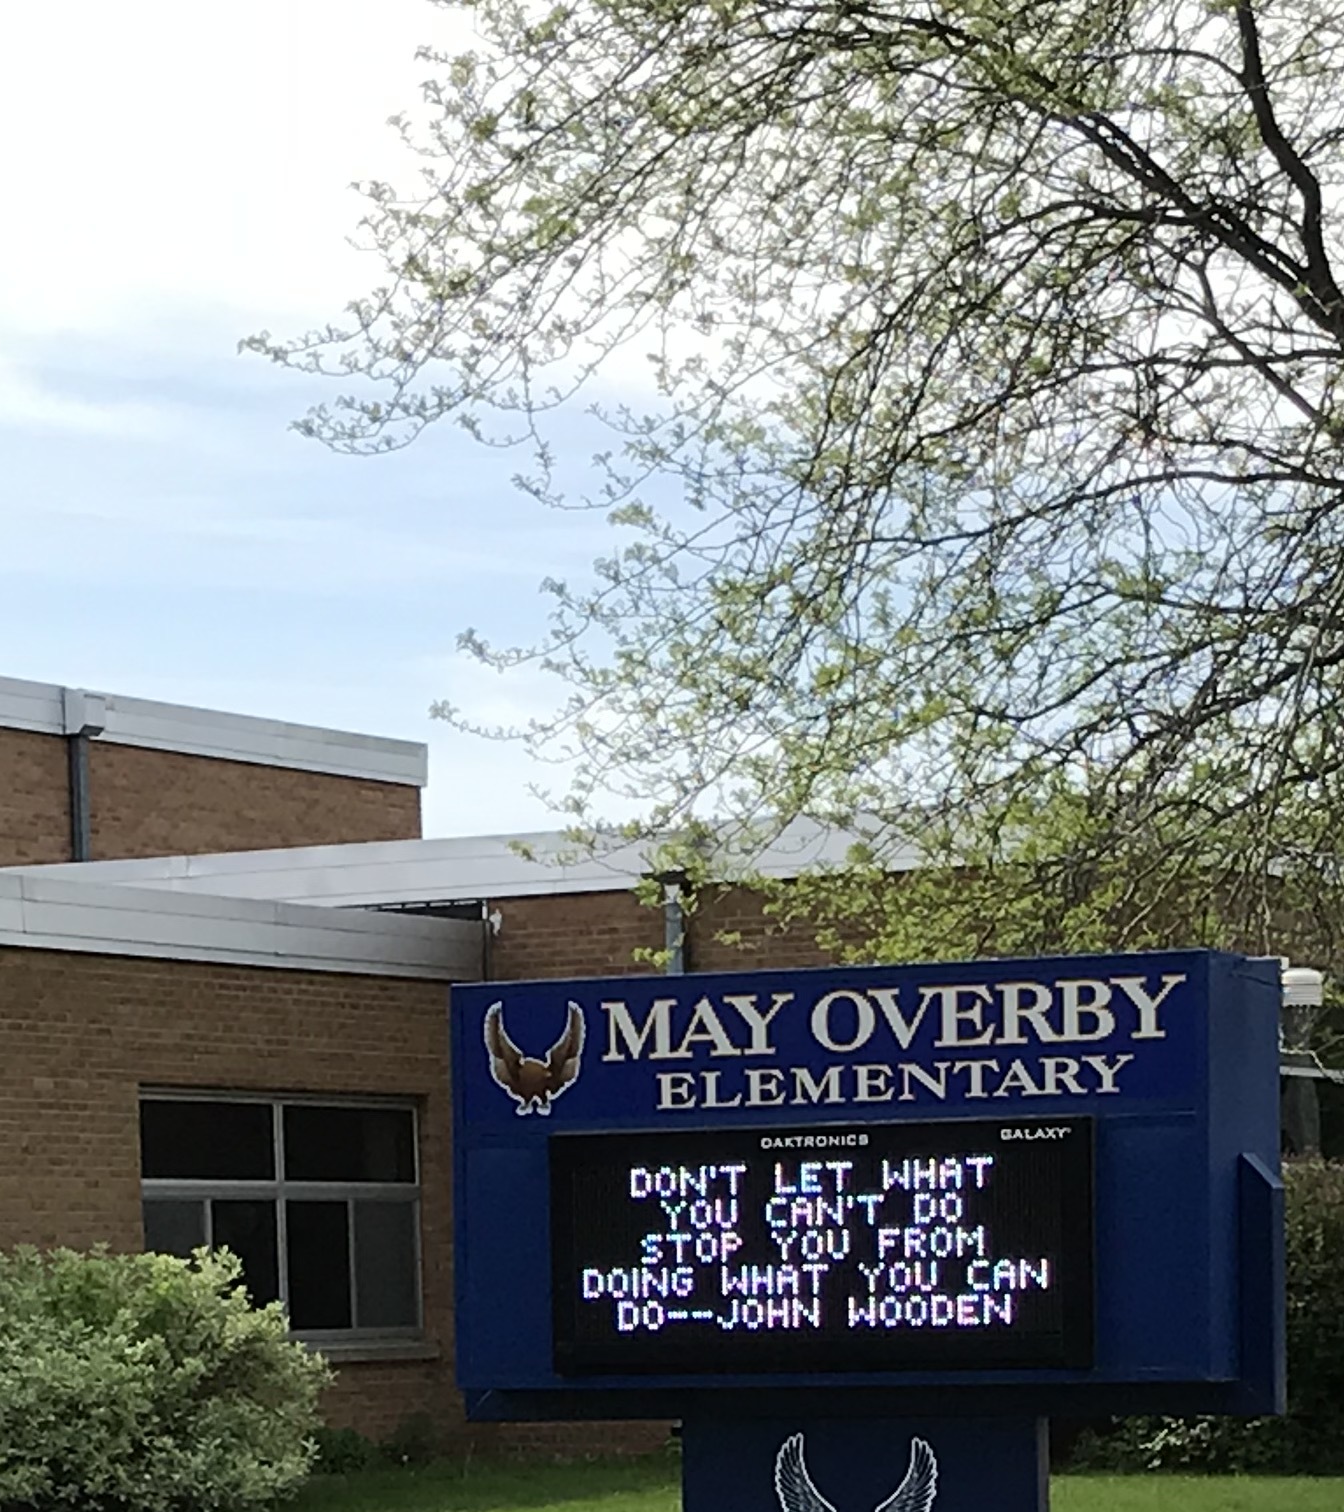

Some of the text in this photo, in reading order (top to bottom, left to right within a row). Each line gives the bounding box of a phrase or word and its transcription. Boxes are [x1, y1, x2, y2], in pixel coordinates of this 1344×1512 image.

[601, 975, 1185, 1061] MAY OVERBY
[656, 1055, 1133, 1109] ELEMENTARY
[761, 1134, 868, 1149] DAKTRONICS
[1001, 1128, 1068, 1140] GALAXY
[630, 1156, 993, 1198] DON'T LET WHAT
[660, 1192, 962, 1230] YOU CAN'T DO
[640, 1226, 985, 1266] STOP YOU FROM
[583, 1259, 1048, 1299] DOING WHAT YOU CAN
[848, 1294, 1011, 1327] WOODEN
